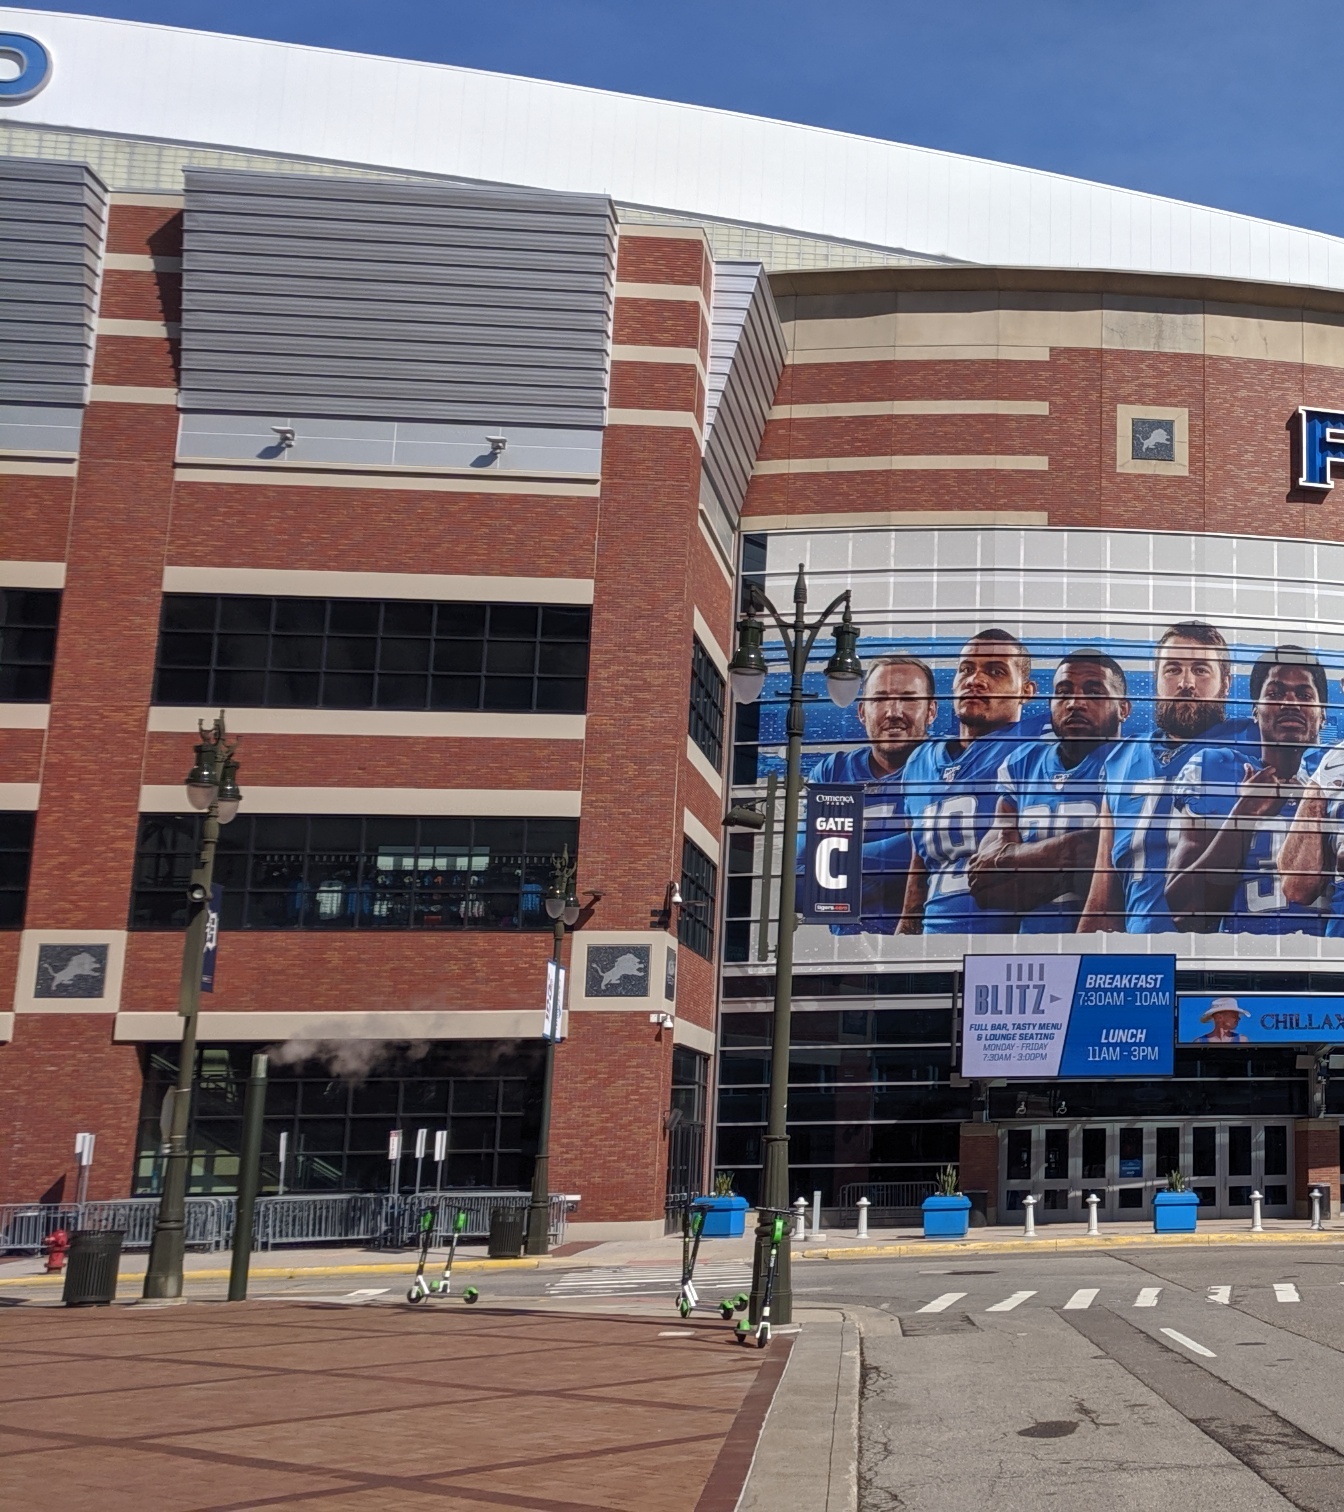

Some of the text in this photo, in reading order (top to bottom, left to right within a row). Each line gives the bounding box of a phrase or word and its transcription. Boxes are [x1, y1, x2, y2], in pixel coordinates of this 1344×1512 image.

[816, 817, 854, 831] GATE
[815, 837, 849, 890] C
[1085, 974, 1164, 988] BREAKFAST
[974, 984, 1046, 1015] BLITZ
[1077, 991, 1125, 1006] 7:30AM
[1135, 991, 1170, 1006] 10AM
[969, 1022, 1063, 1032] FULL BAR, TASTY MENU
[976, 1032, 1056, 1041] & LOUNGE SEATING
[1101, 1028, 1147, 1043] LUNCH
[983, 1043, 1015, 1051] MONDAY
[1020, 1042, 1049, 1051] FRIDAY
[1087, 1046, 1120, 1061] 11AM
[1130, 1046, 1159, 1061] 3PM
[982, 1053, 1012, 1062] 7:30AM
[1016, 1052, 1048, 1061] 3:00PM
